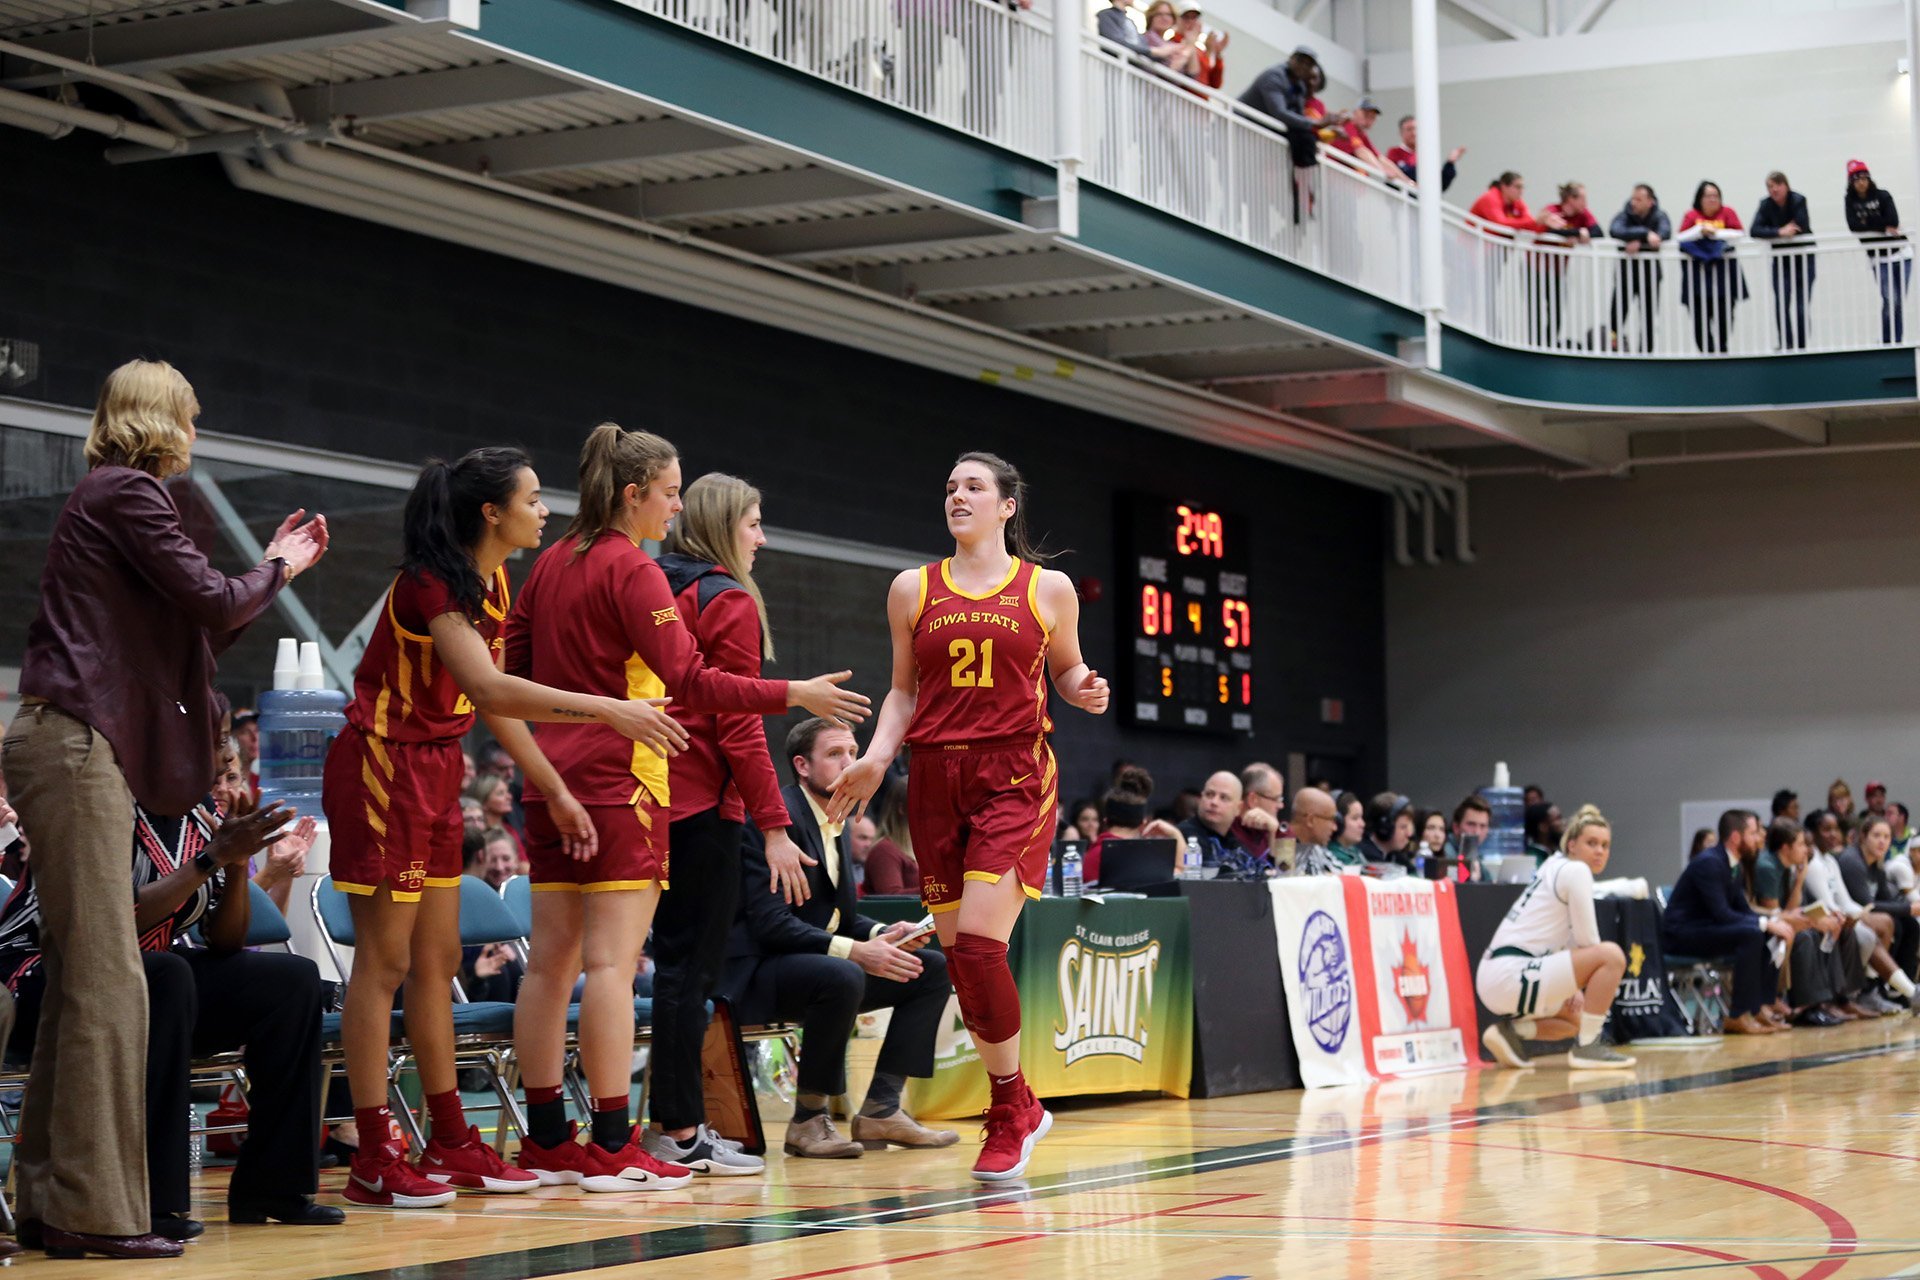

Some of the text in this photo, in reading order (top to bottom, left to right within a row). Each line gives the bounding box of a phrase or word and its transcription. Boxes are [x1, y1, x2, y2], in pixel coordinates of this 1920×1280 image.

[928, 612, 1020, 634] IOWA STATE
[1142, 585, 1172, 635] 81
[1188, 602, 1201, 633] 4
[1223, 599, 1250, 647] 57
[948, 638, 994, 688] 21
[1075, 924, 1150, 947] ST. CLAIR COLLEGE
[1054, 940, 1160, 1050] SAINTS
